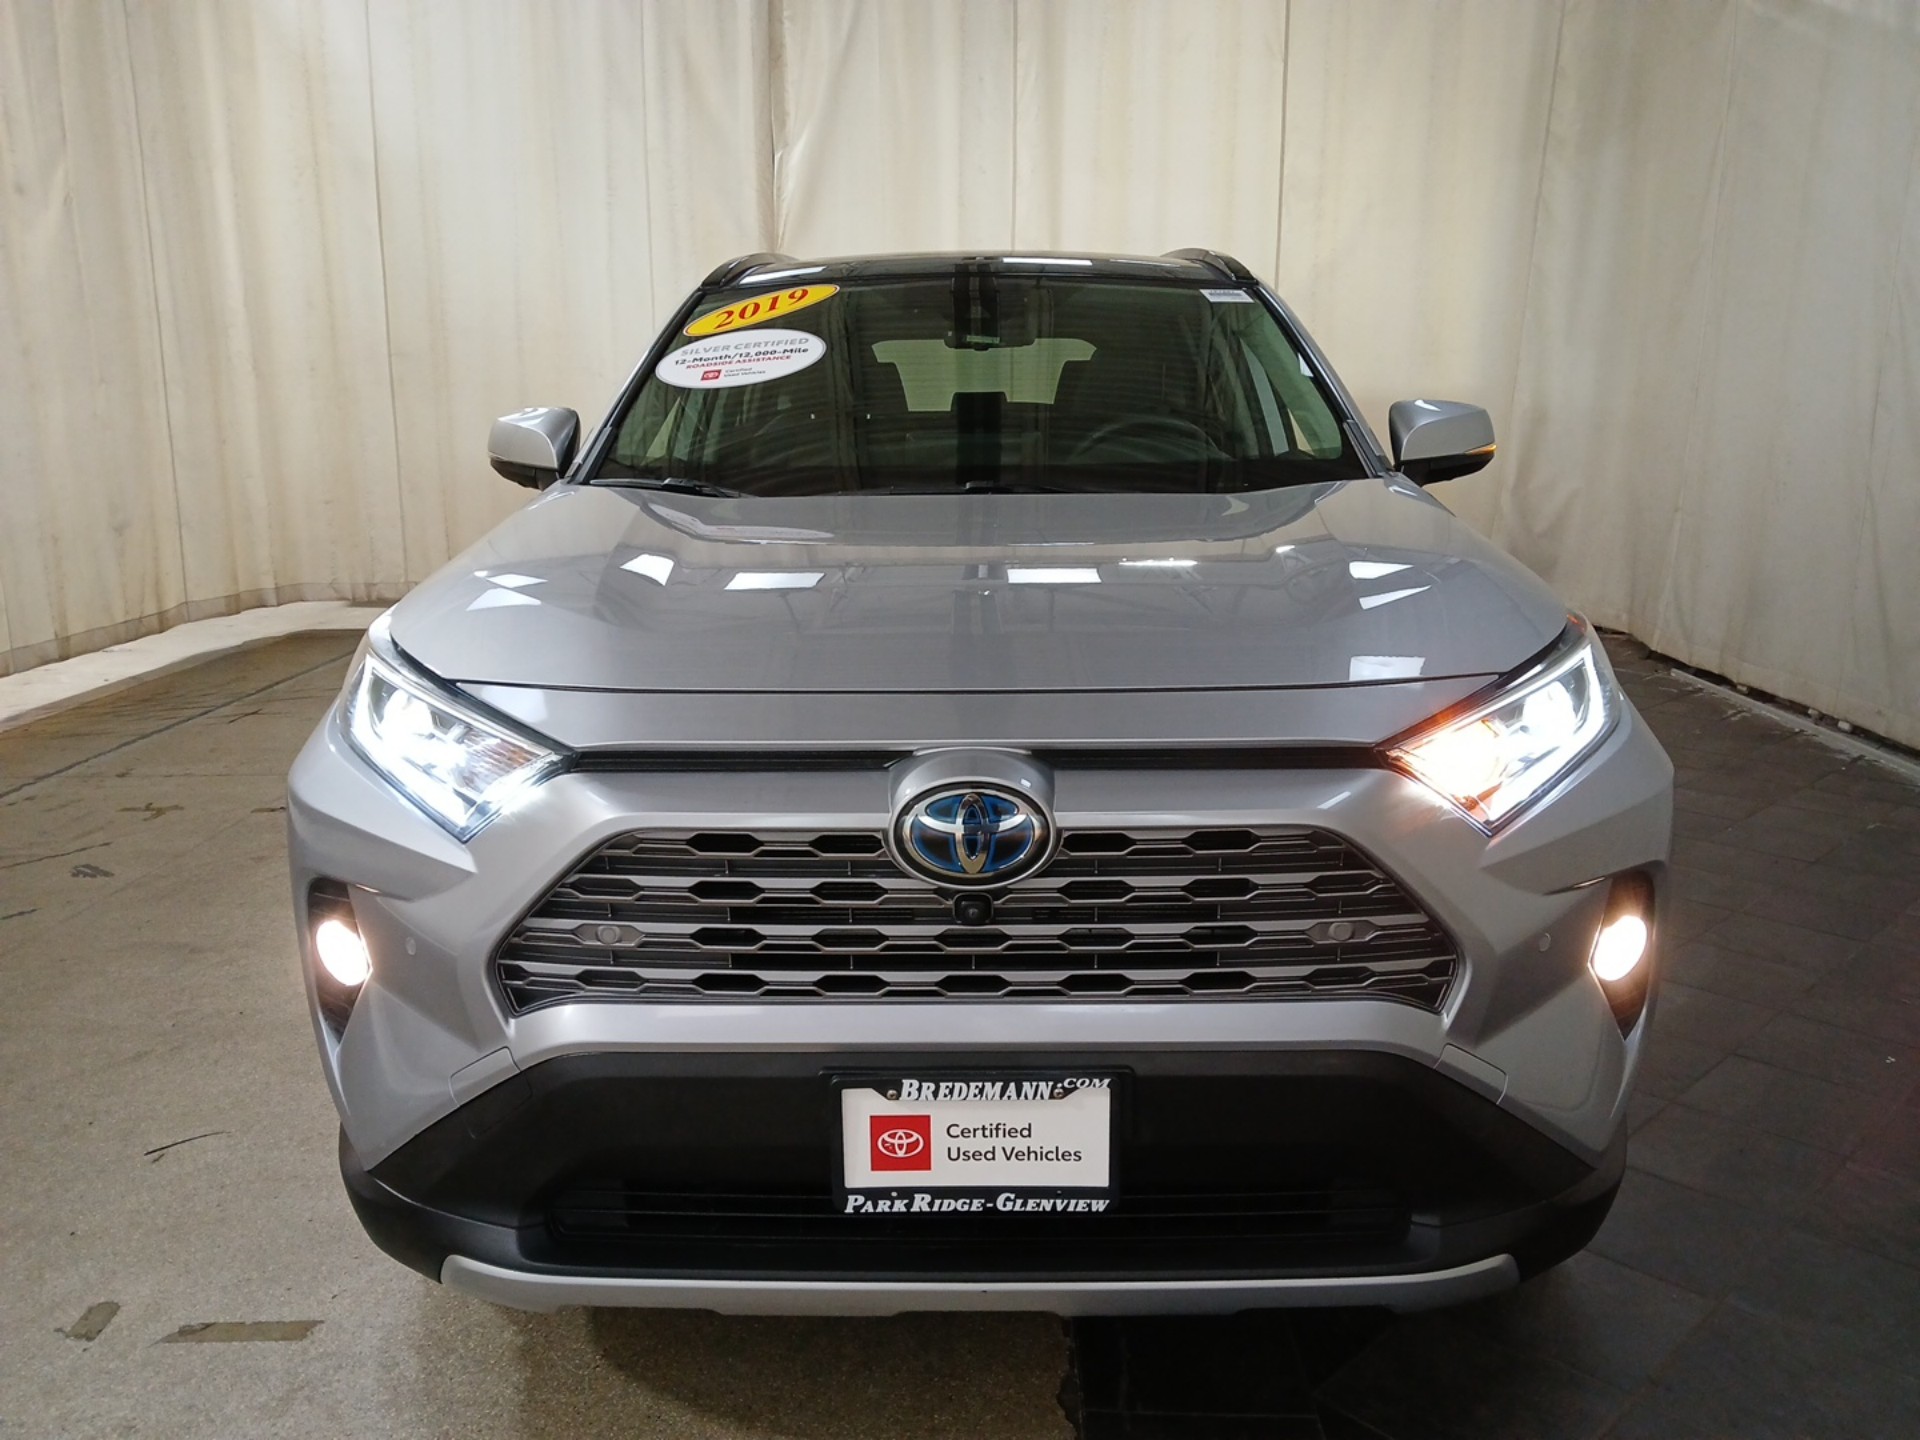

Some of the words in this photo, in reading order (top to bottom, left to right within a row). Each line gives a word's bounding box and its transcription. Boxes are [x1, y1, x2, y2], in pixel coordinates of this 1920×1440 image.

[715, 288, 808, 329] 2019
[681, 344, 731, 356] SILVER
[734, 338, 809, 350] CERTIFIED
[686, 360, 733, 369] ROADSIDE
[735, 355, 791, 364] ASSISTANCE
[946, 1123, 1032, 1138] Certified
[947, 1147, 996, 1162] Used
[1002, 1146, 1082, 1162] Vehicles
[845, 1194, 909, 1213] PARK
